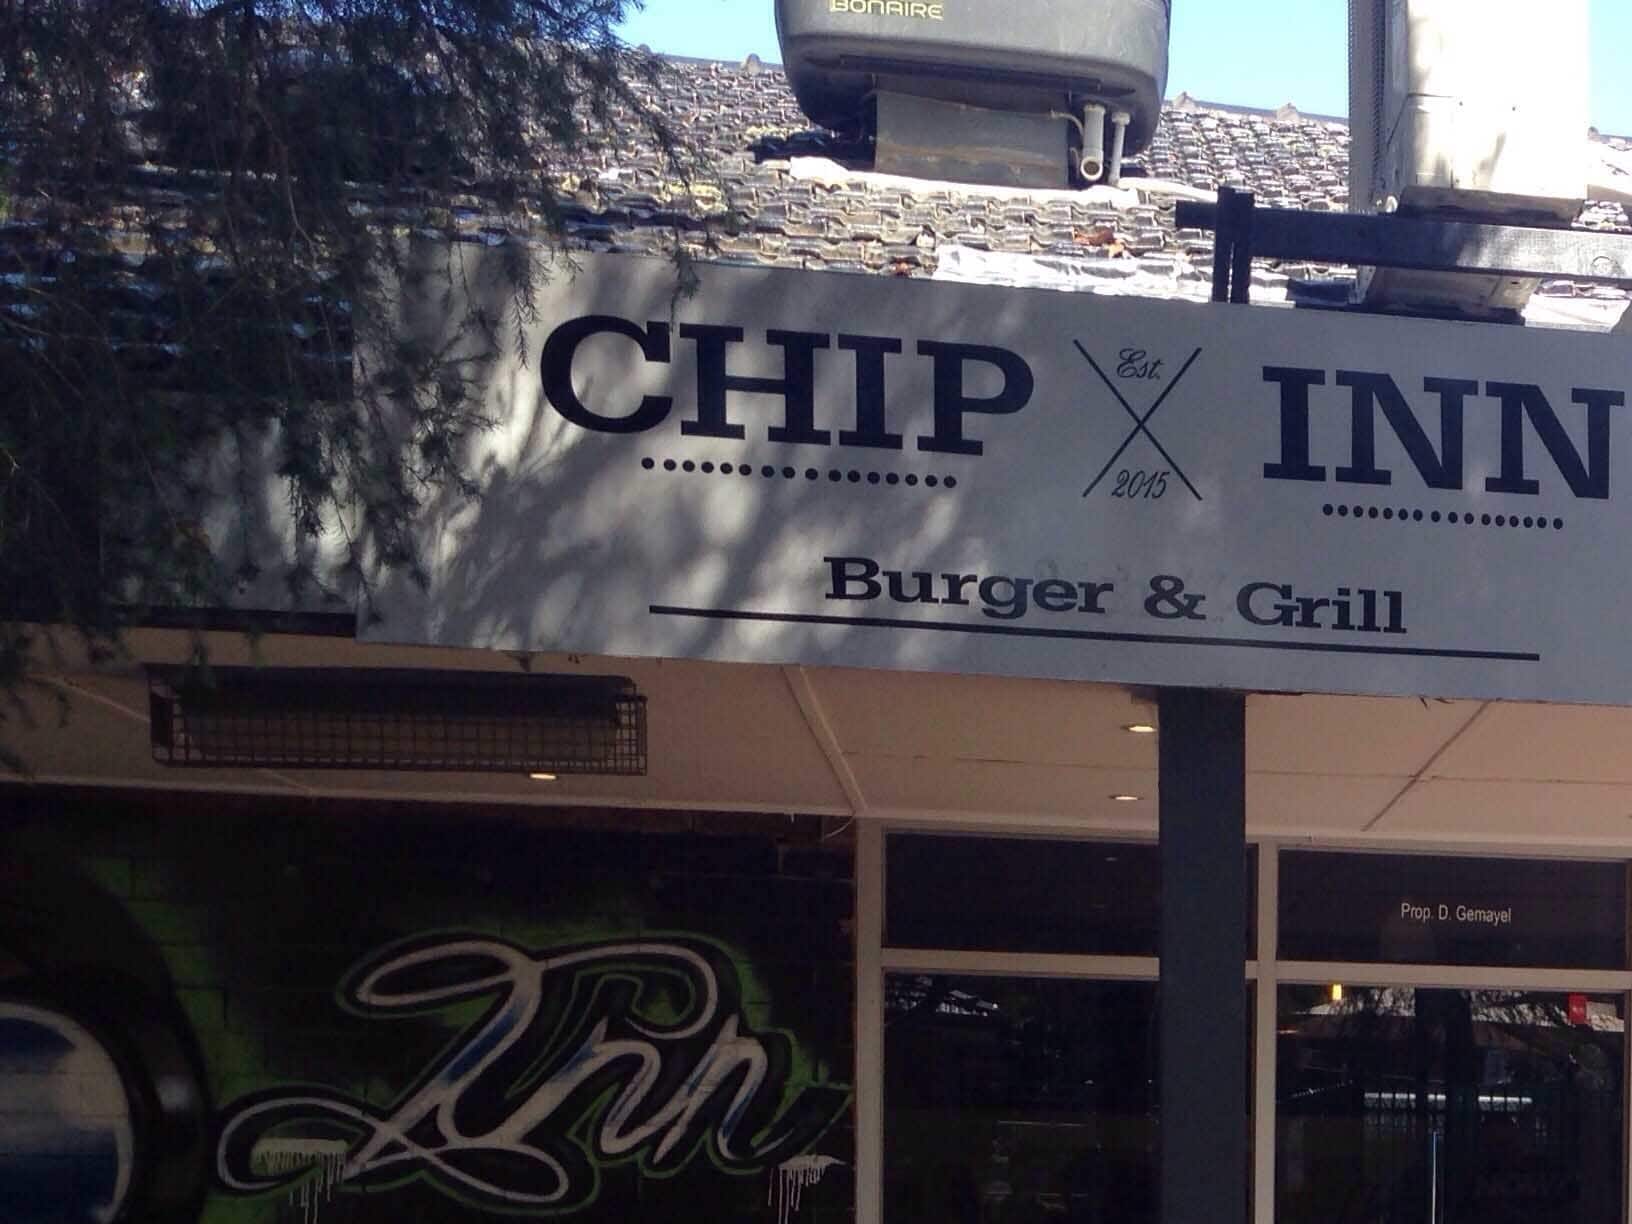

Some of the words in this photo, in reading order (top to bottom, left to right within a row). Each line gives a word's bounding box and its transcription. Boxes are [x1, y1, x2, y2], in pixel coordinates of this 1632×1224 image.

[830, 0, 944, 21] BONAIRE
[1116, 347, 1162, 381] Est.
[541, 315, 1034, 456] CHIP
[1262, 366, 1625, 499] INN
[1111, 468, 1171, 499] 2015
[823, 556, 1113, 620] Burger
[1143, 575, 1207, 620] &
[1236, 582, 1408, 634] Grill
[1401, 902, 1434, 924] Prop.
[1438, 904, 1452, 921] D.
[1456, 905, 1512, 926] Gemayel
